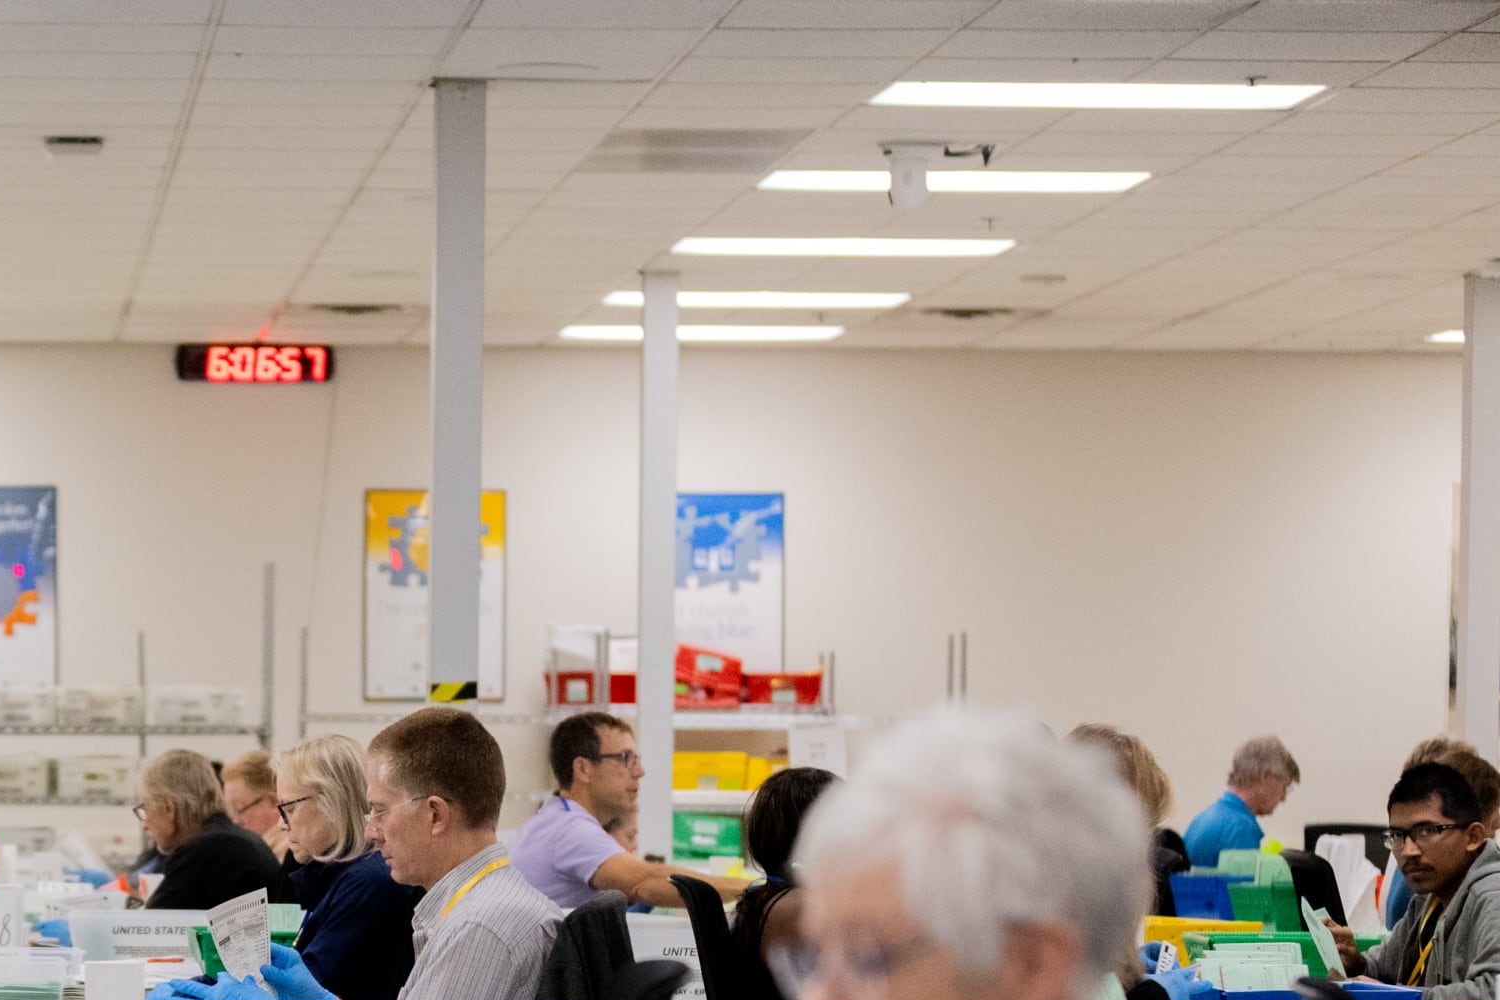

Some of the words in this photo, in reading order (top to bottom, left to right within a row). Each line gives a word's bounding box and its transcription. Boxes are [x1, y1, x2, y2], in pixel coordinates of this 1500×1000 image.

[112, 926, 152, 935] UNITED
[155, 926, 187, 935] STATE
[662, 947, 697, 957] UNITE
